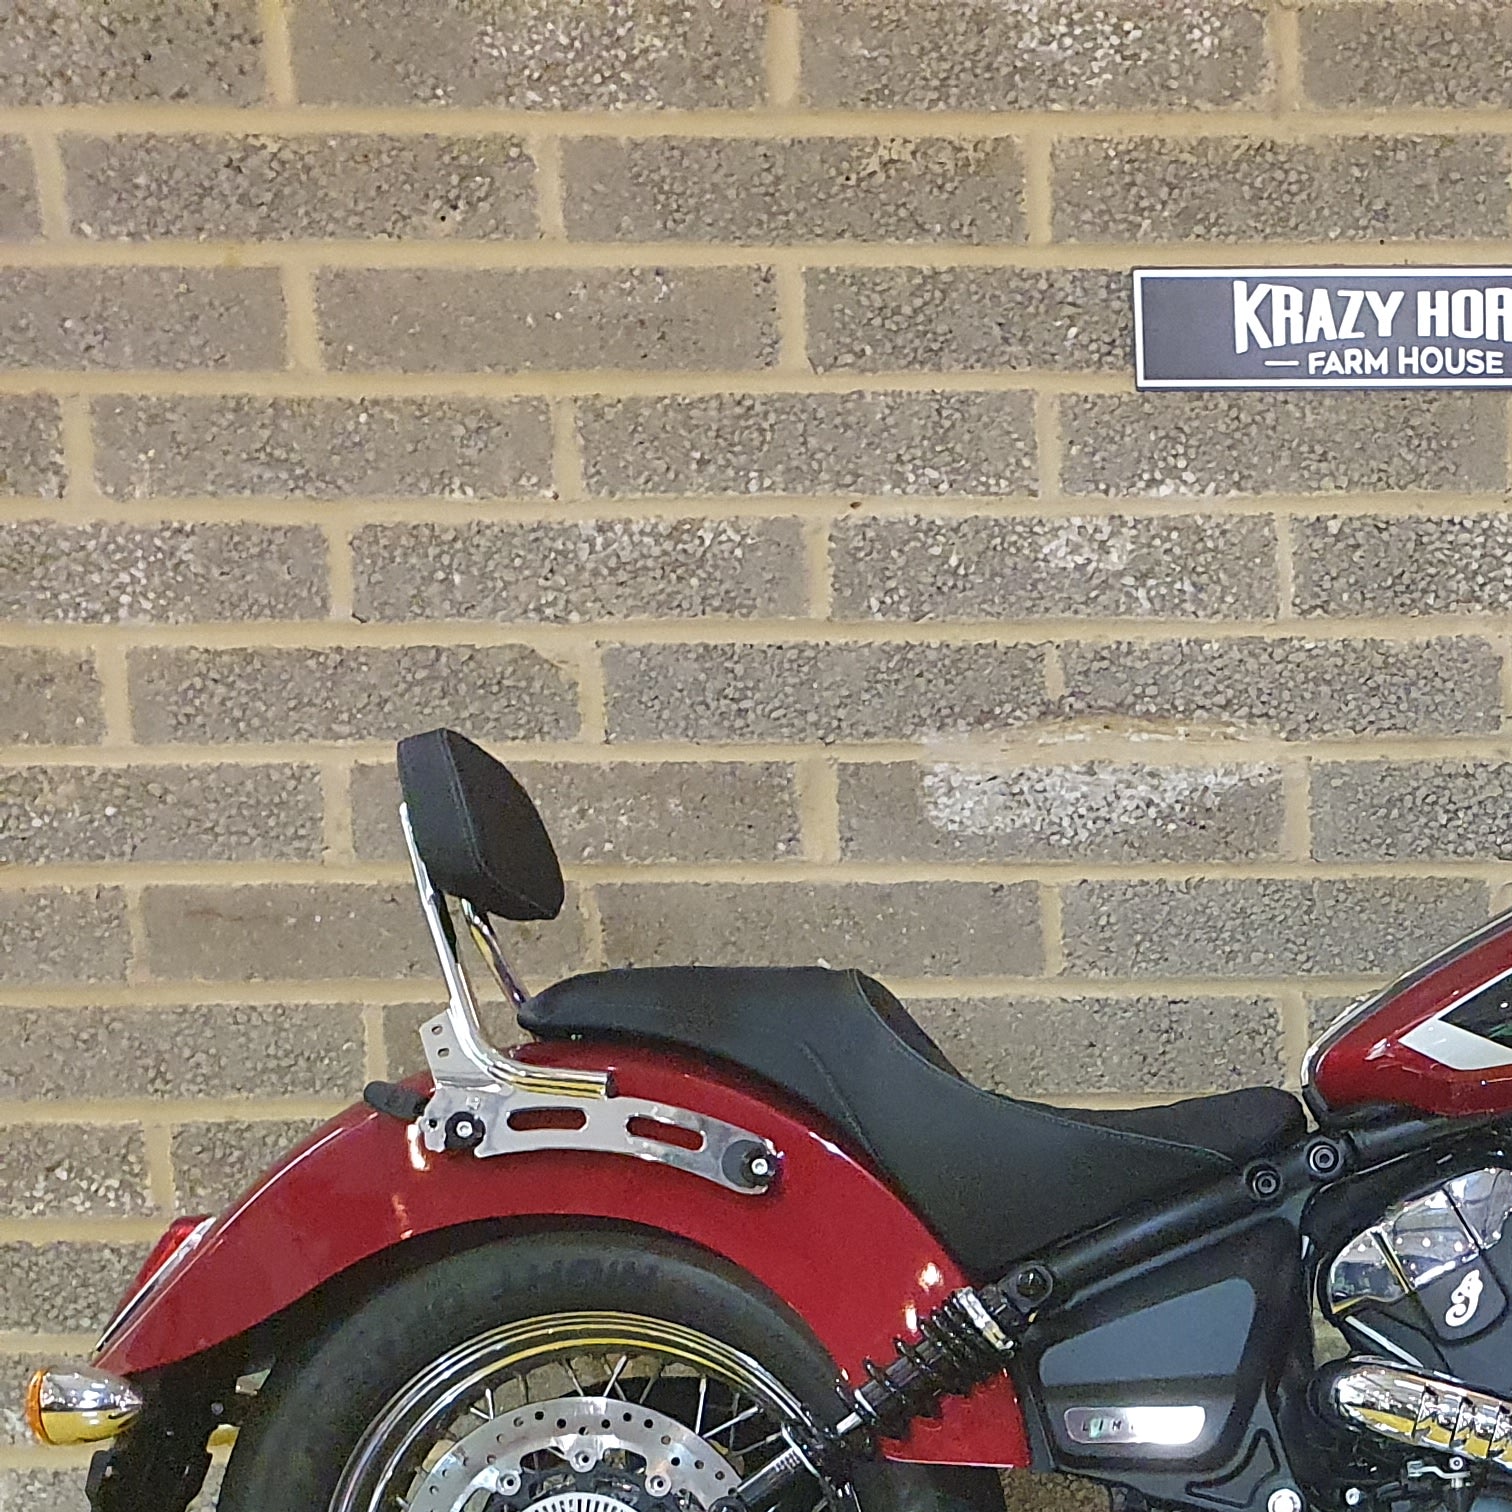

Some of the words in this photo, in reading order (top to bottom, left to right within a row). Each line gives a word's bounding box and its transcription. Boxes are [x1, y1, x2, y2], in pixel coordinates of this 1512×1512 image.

[1233, 280, 1405, 354] KRAZY
[1308, 348, 1389, 376] FARM
[1398, 346, 1504, 376] HOUSE
